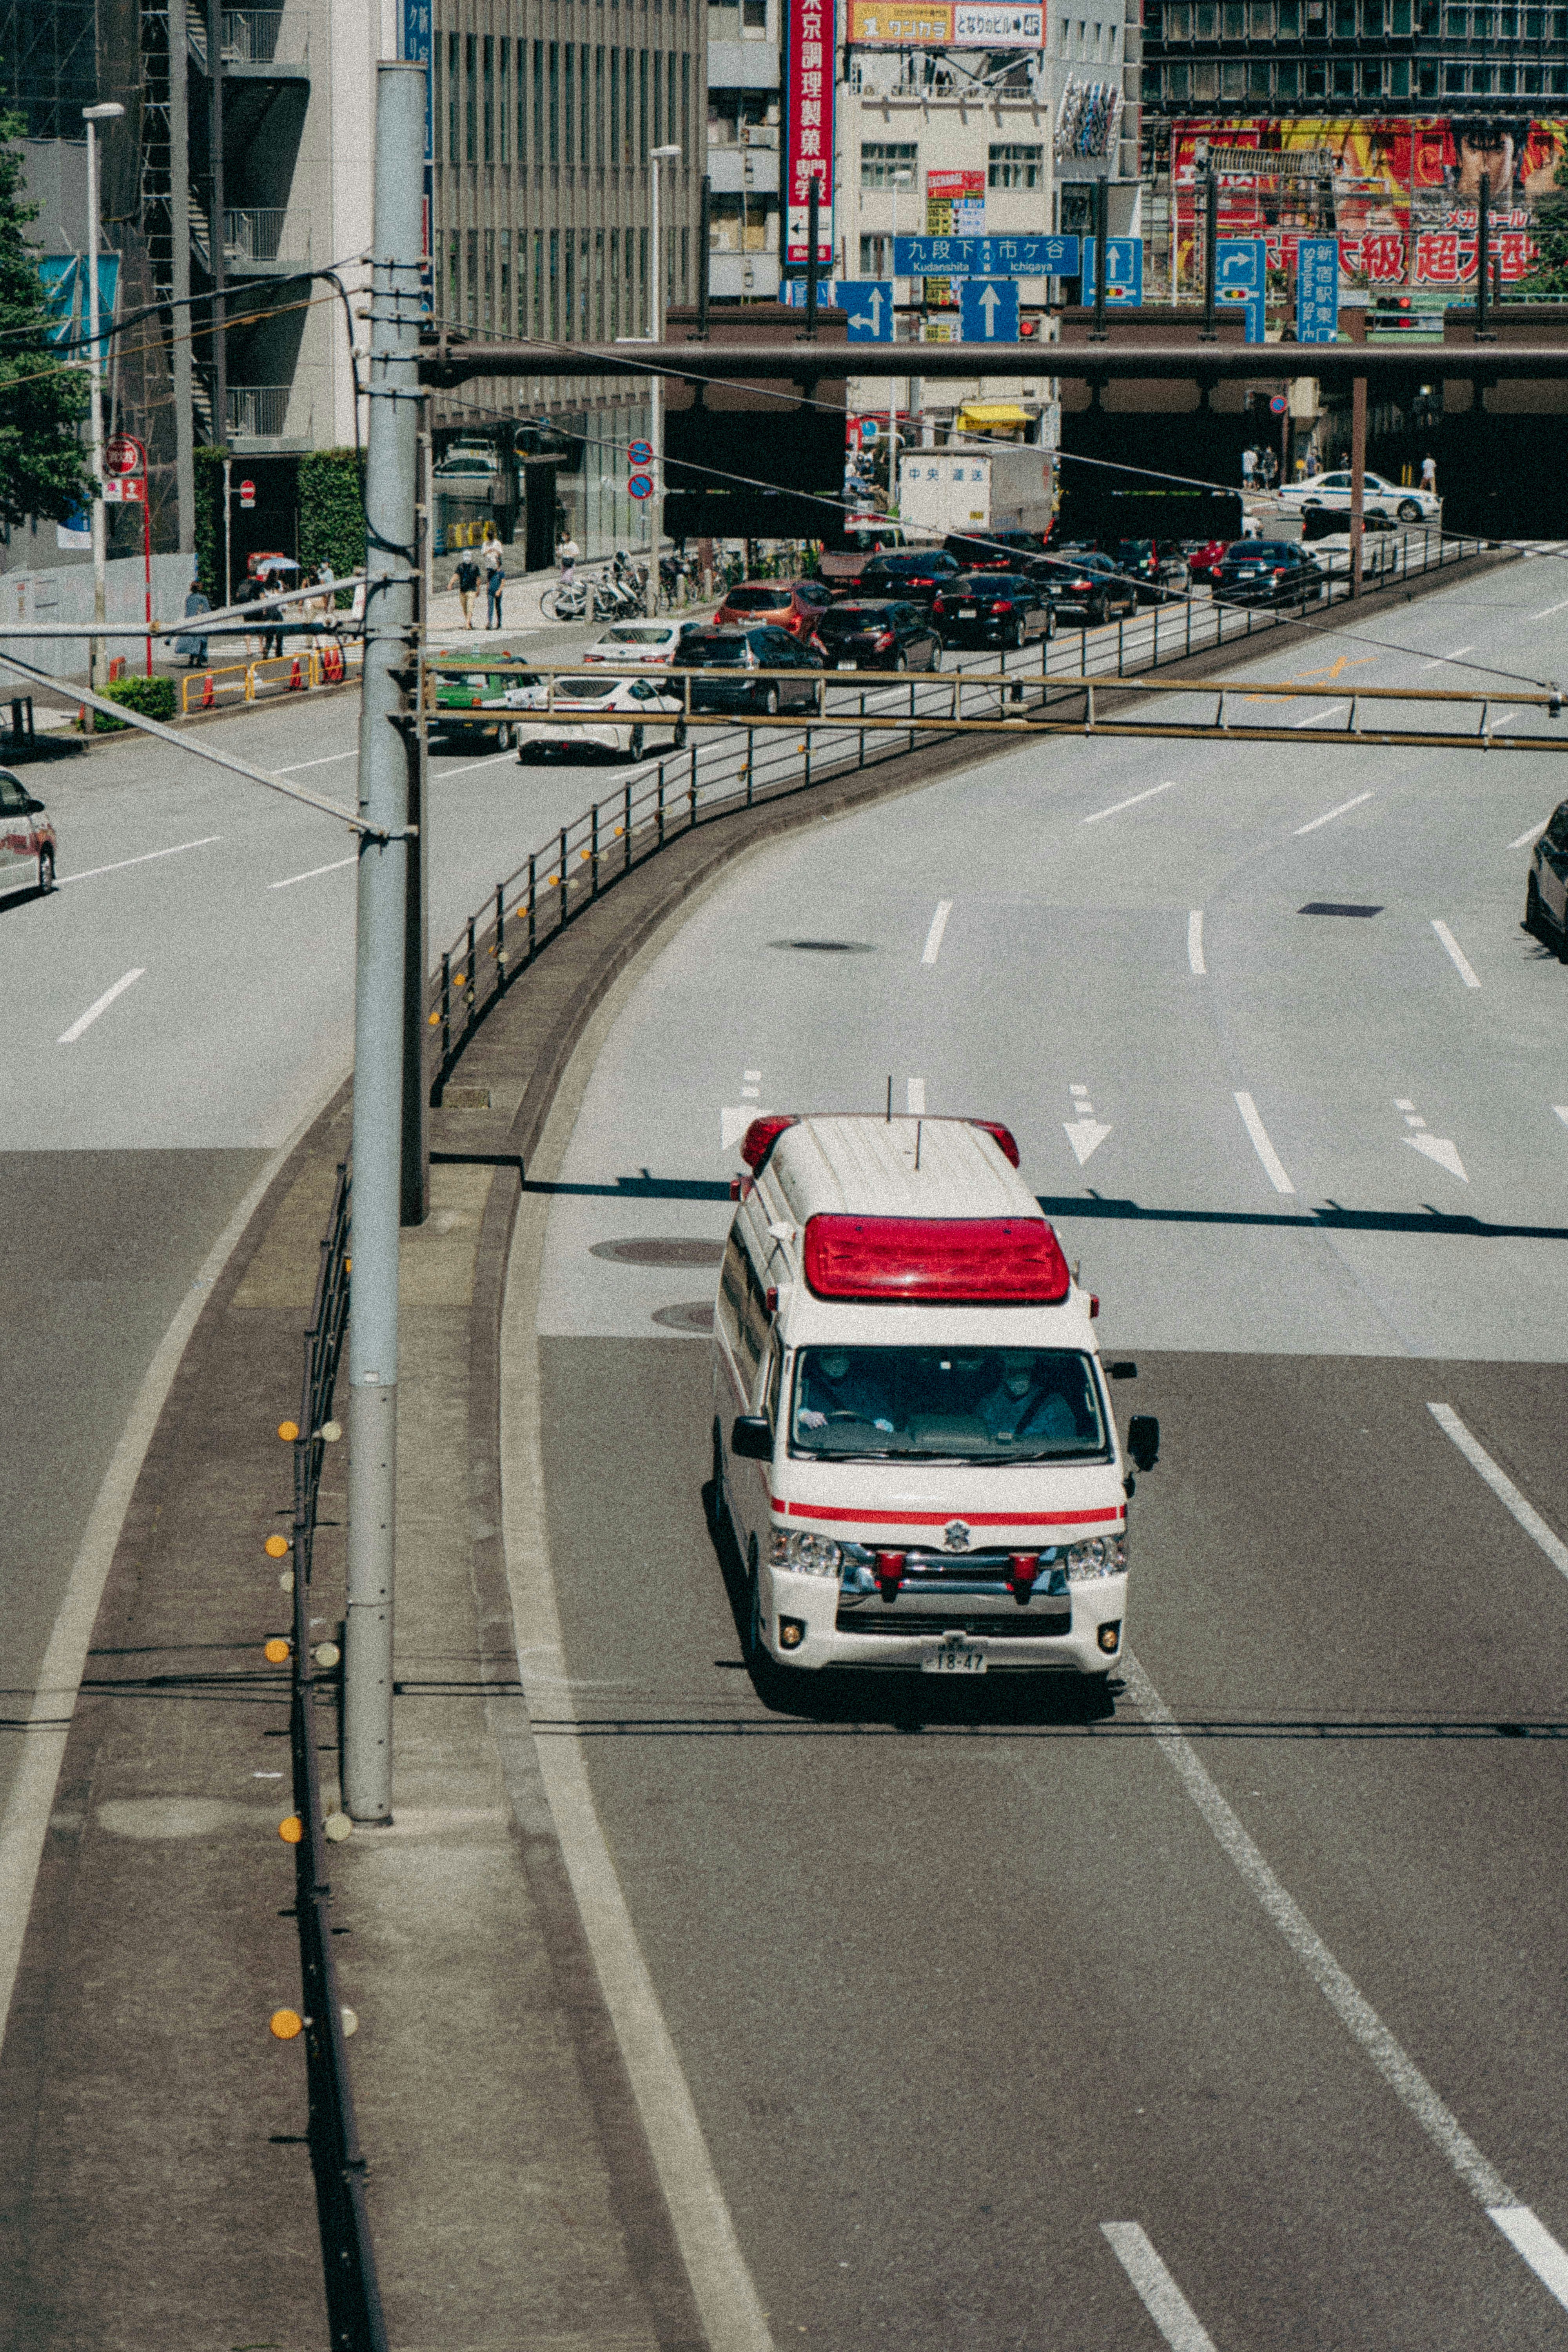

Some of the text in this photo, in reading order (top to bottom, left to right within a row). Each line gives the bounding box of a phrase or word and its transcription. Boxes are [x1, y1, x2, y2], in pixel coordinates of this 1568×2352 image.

[888, 20, 946, 37] ワンカラ
[957, 15, 1011, 34] となりのビル
[908, 240, 975, 260] 九段下
[913, 262, 970, 272] Kudanshita
[1010, 262, 1053, 274] Ichigaya
[1303, 247, 1315, 297] Shinjuku
[938, 1653, 983, 1670] 18-47
